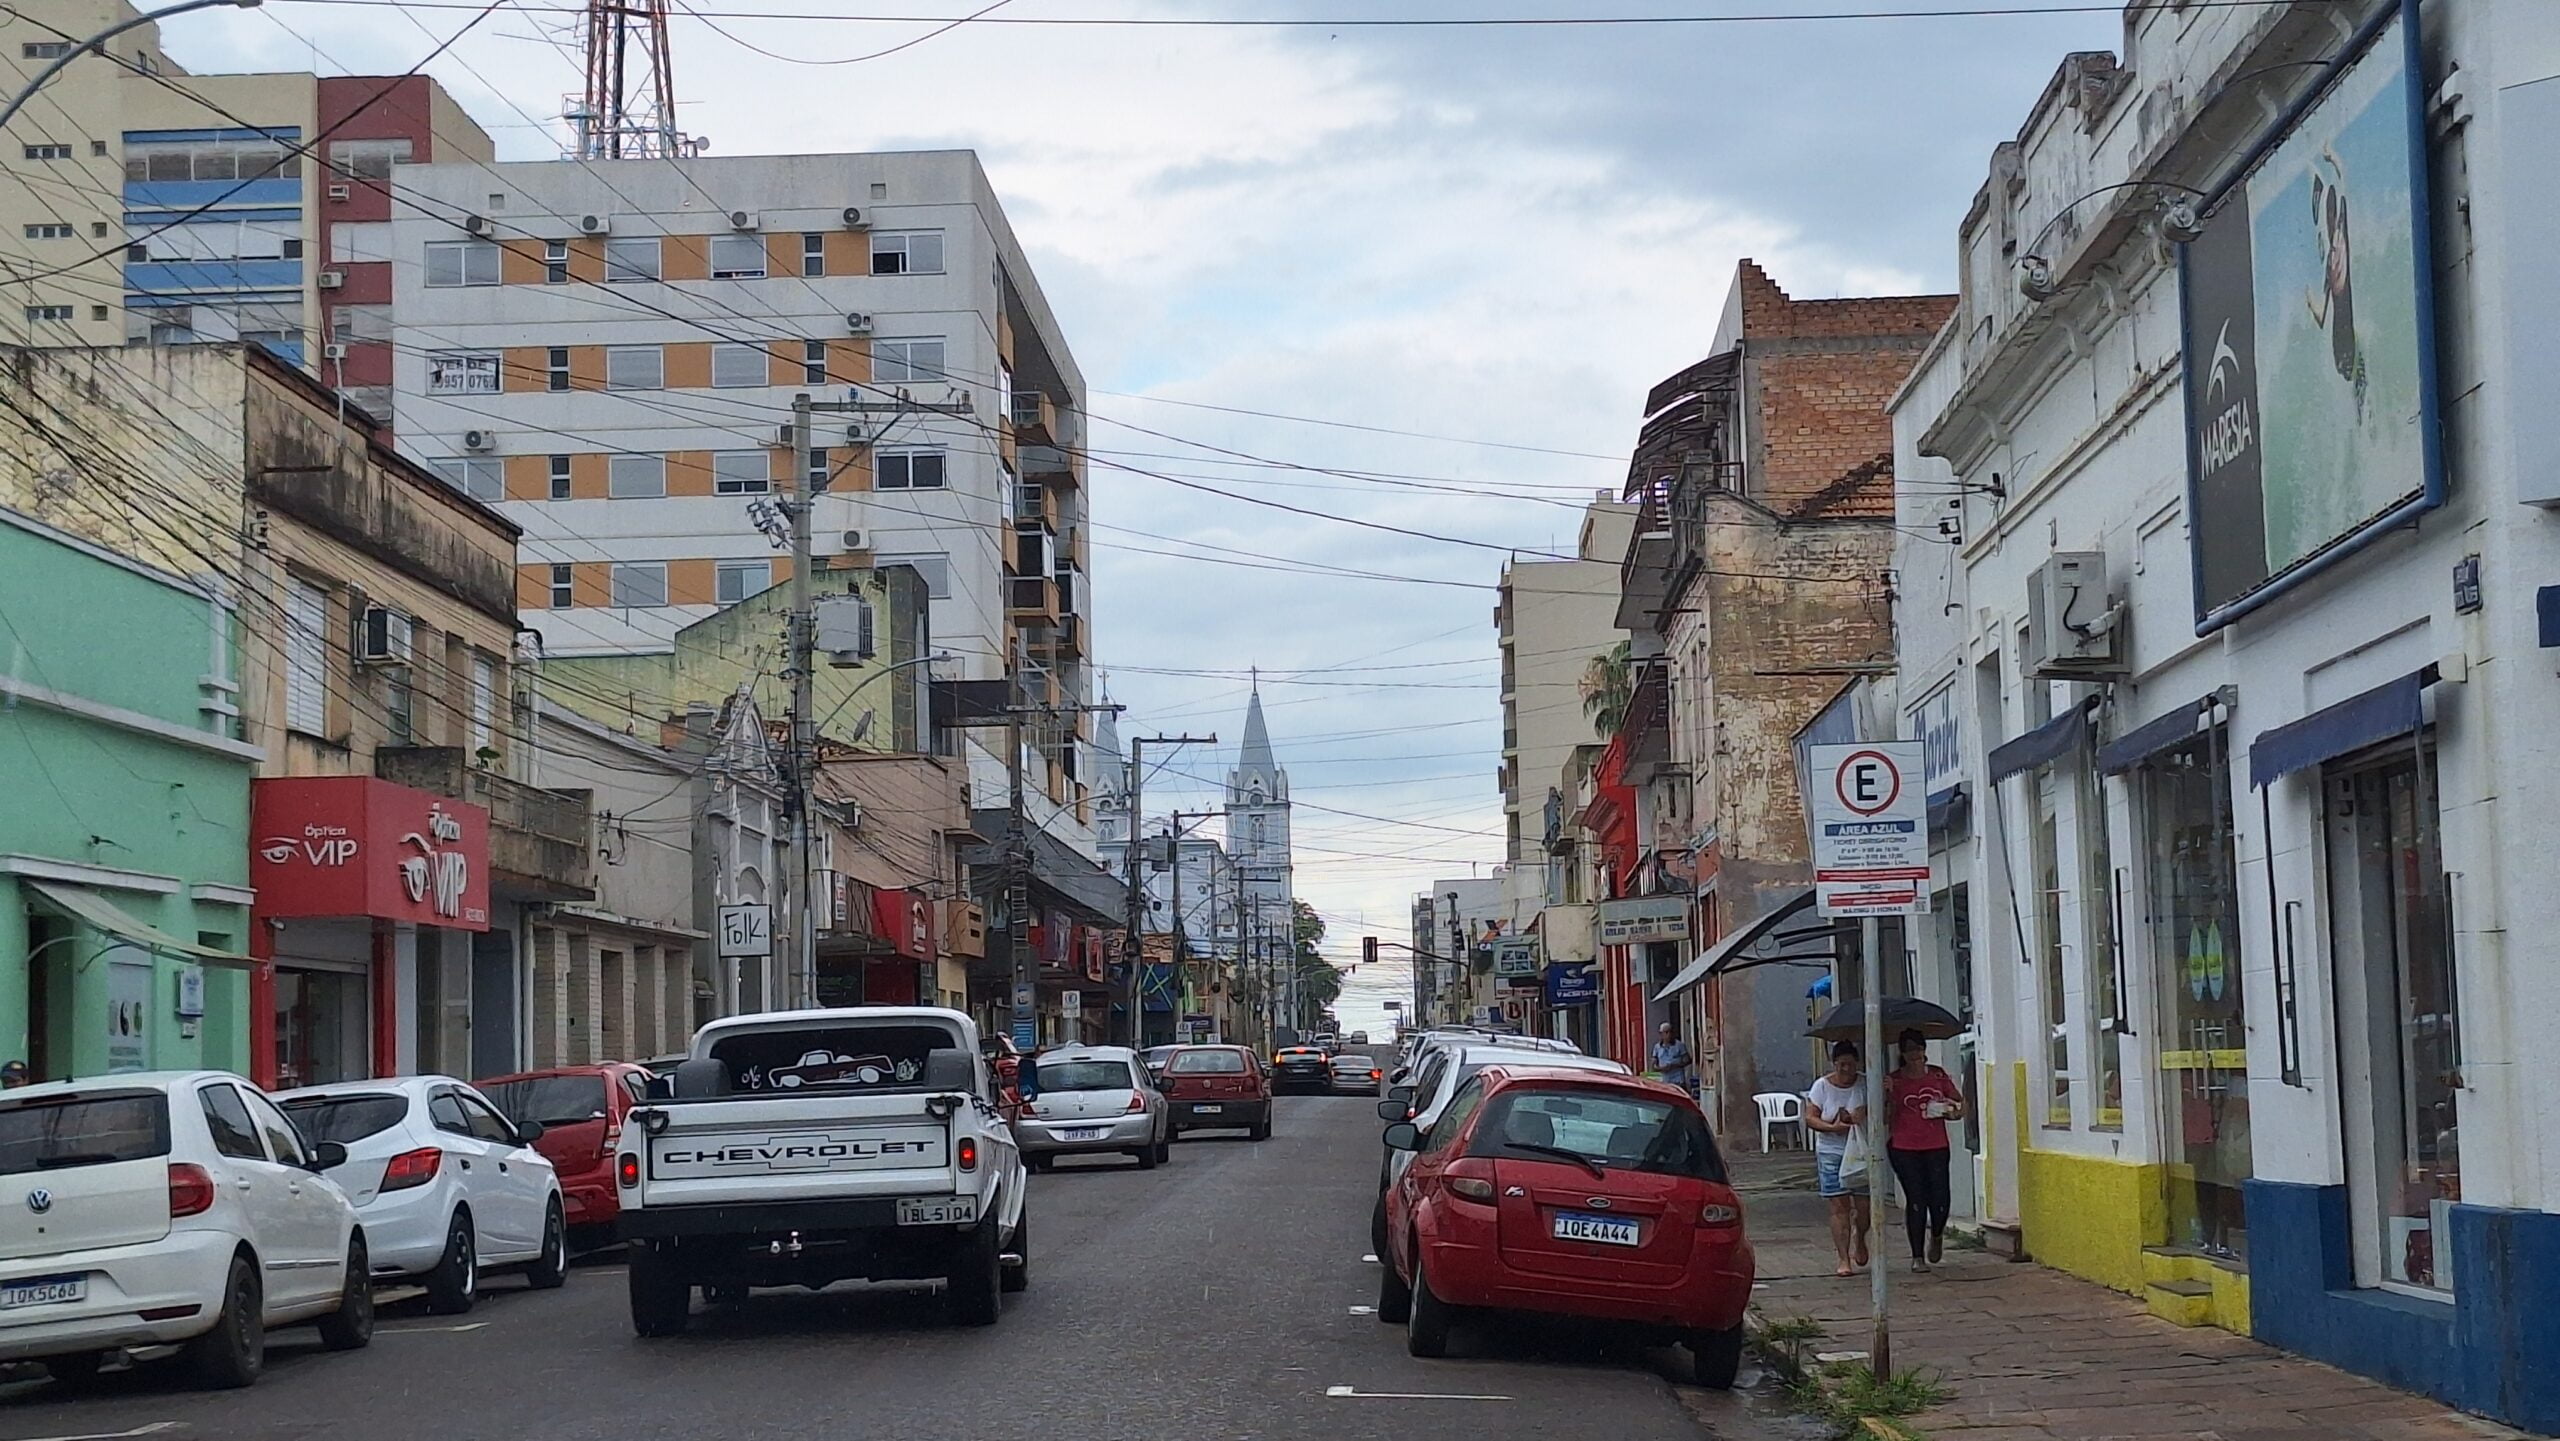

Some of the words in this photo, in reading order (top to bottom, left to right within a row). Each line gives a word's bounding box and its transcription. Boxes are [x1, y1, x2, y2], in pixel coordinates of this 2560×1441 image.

[2200, 397, 2253, 481] MARESIA
[1856, 764, 1878, 801] E
[1870, 823, 1901, 834] AZUL
[303, 839, 358, 865] VIP
[429, 851, 467, 918] VIP
[664, 1141, 935, 1164] CHEVROLET
[1562, 1220, 1630, 1242] IQE4A44
